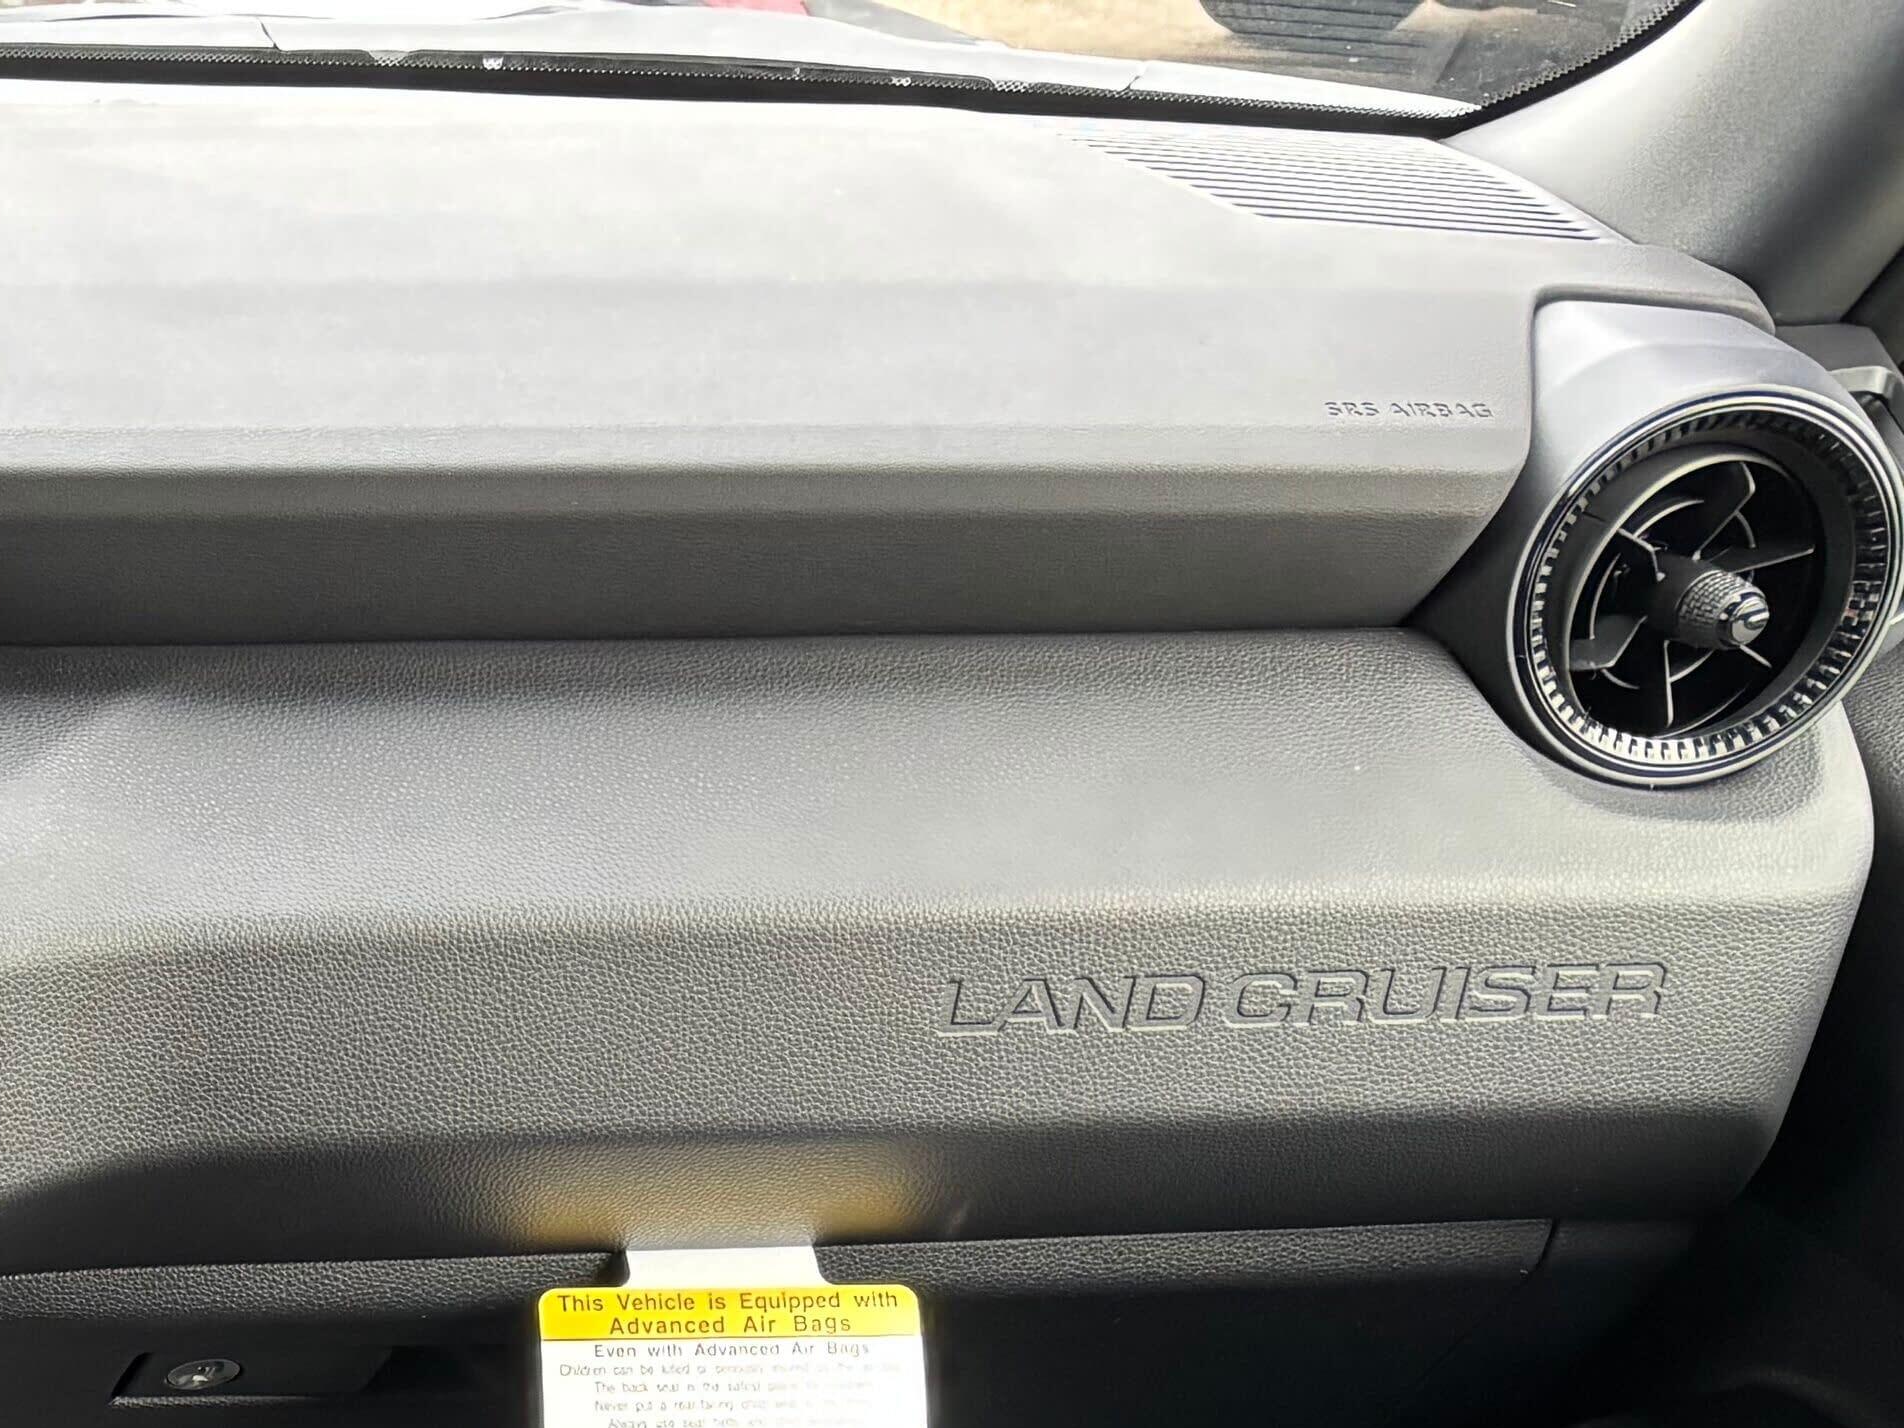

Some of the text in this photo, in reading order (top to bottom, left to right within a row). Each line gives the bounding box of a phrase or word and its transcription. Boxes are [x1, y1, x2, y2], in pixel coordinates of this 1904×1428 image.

[1325, 401, 1494, 418] SRS AIRBAG
[936, 961, 1667, 1037] LAND CRUISER
[557, 1290, 898, 1313] This Vehicle is Equipped with
[609, 1314, 852, 1336] Advanced Air Bags
[594, 1343, 637, 1358] Even
[647, 1343, 683, 1357] with
[694, 1342, 780, 1357] Advanced
[791, 1341, 814, 1356] Air
